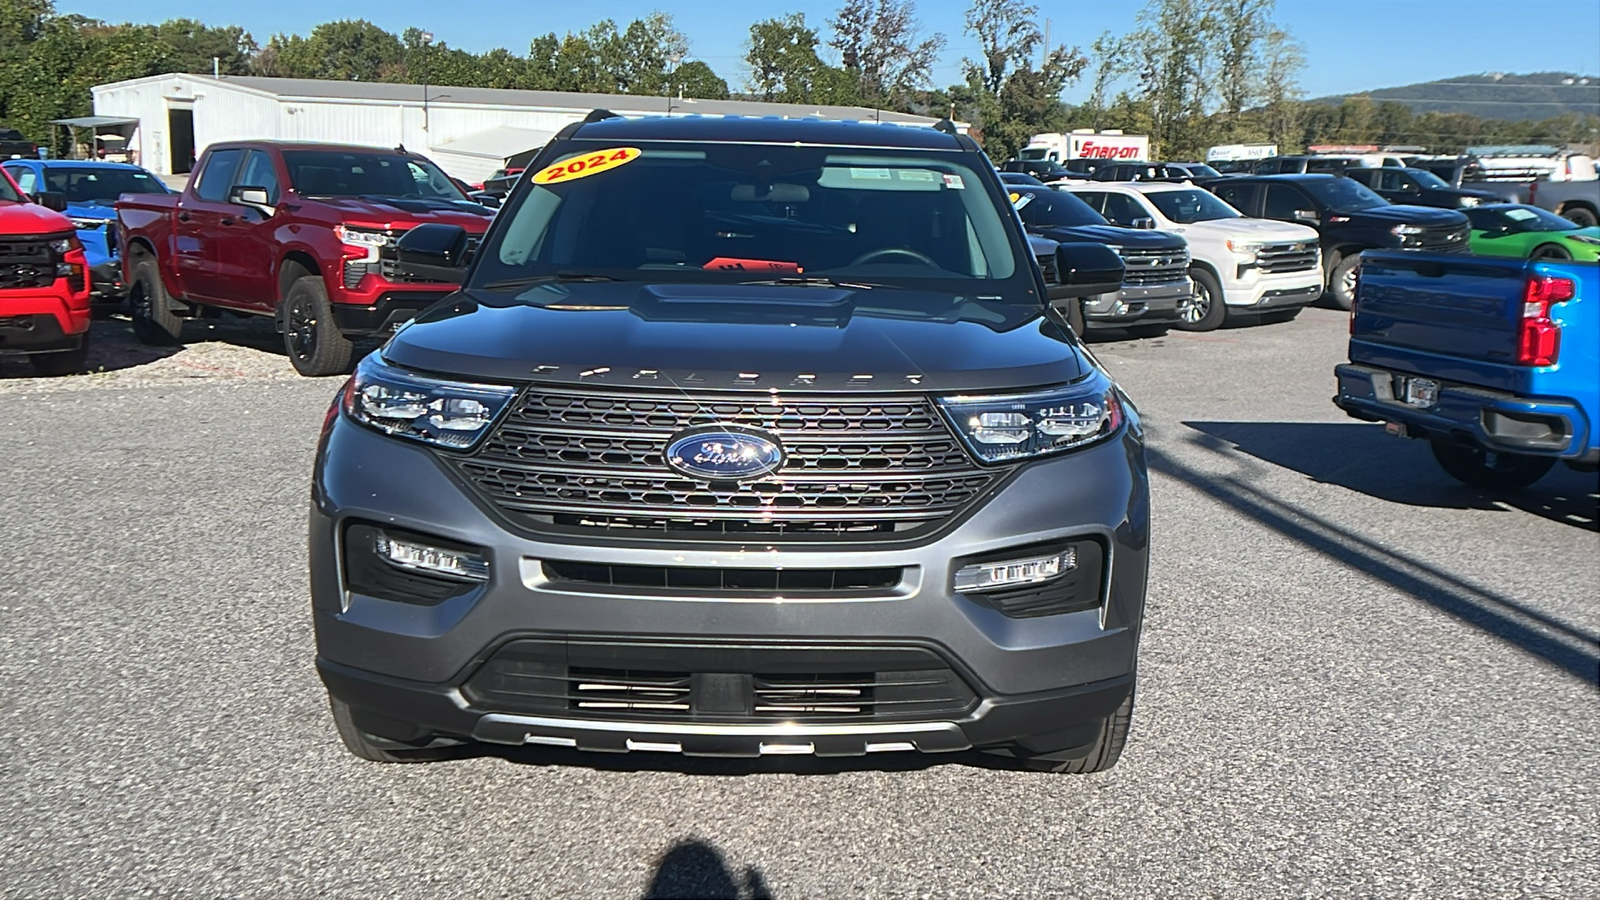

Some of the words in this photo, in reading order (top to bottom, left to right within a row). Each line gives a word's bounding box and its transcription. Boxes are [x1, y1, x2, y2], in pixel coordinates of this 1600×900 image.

[1079, 141, 1139, 159] Snap-on
[546, 149, 630, 181] 2024
[530, 364, 923, 387] EXPLORER
